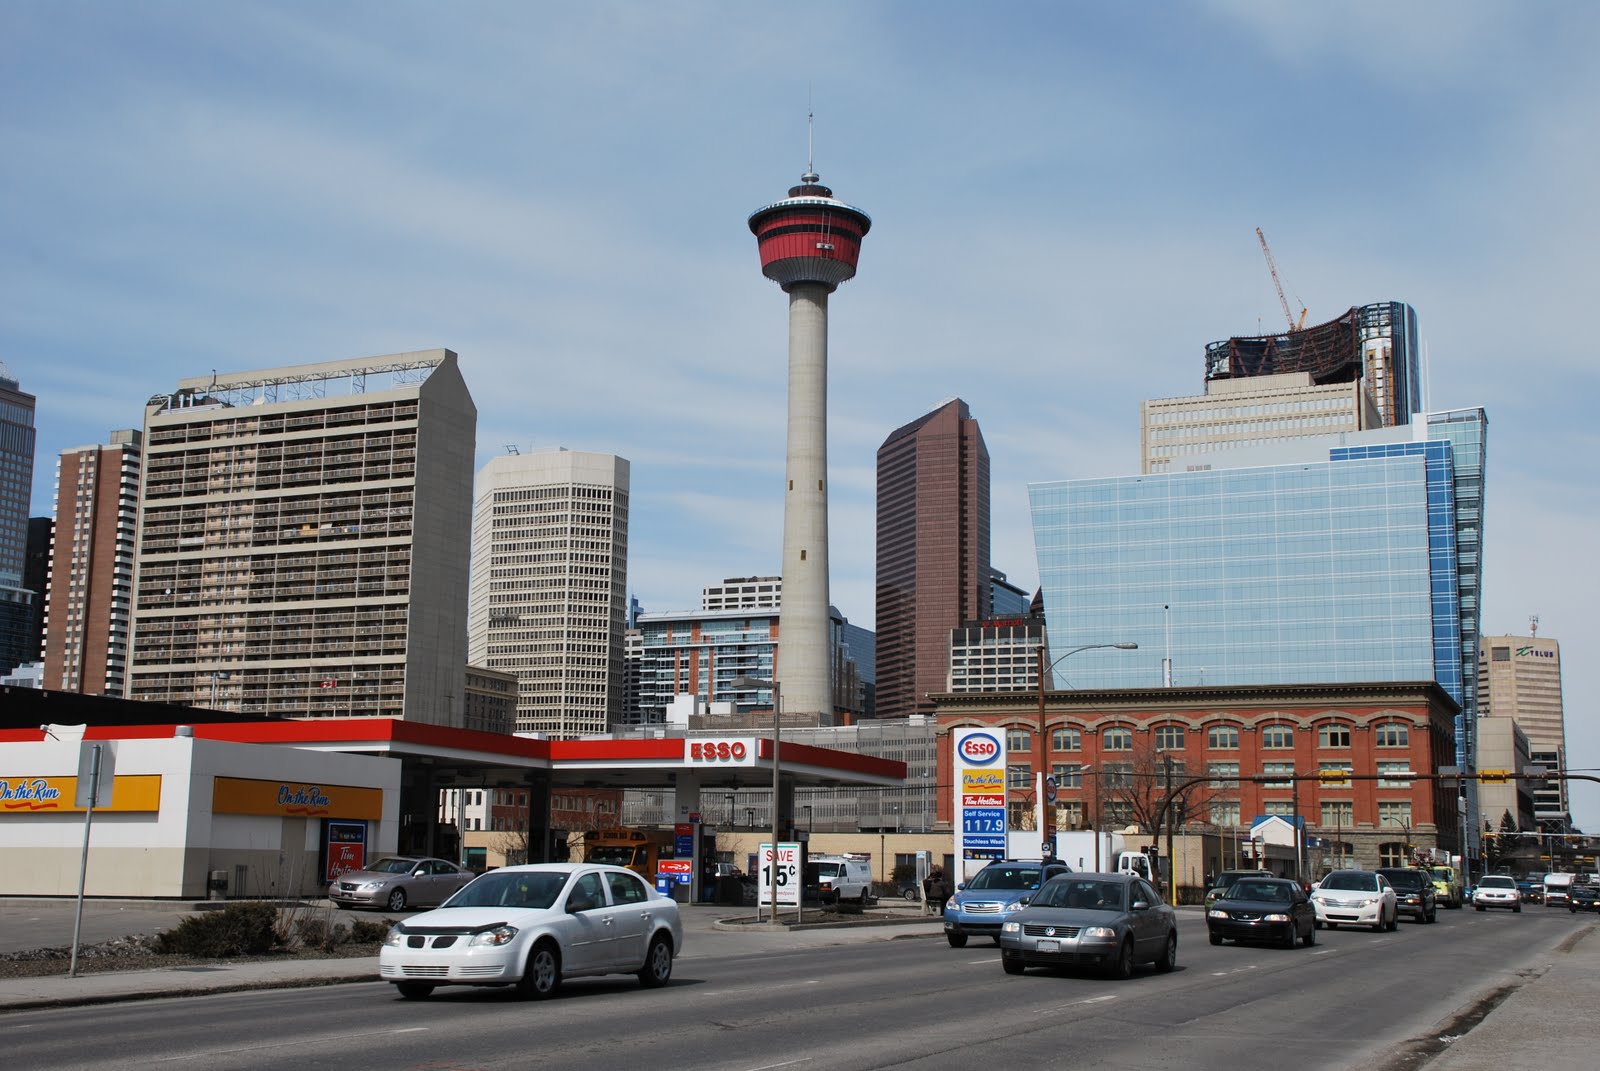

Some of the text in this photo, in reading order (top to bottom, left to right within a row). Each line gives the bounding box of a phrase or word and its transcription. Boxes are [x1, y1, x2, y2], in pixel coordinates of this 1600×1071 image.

[1530, 650, 1554, 658] TELUS
[691, 742, 746, 758] ESSO
[965, 741, 994, 755] Esso
[963, 774, 1004, 784] On the Run
[0, 779, 60, 802] On the Run
[278, 784, 329, 807] On the Run
[964, 796, 1002, 805] Tim Hortons
[965, 819, 1004, 832] 117.9
[340, 846, 354, 860] Tim
